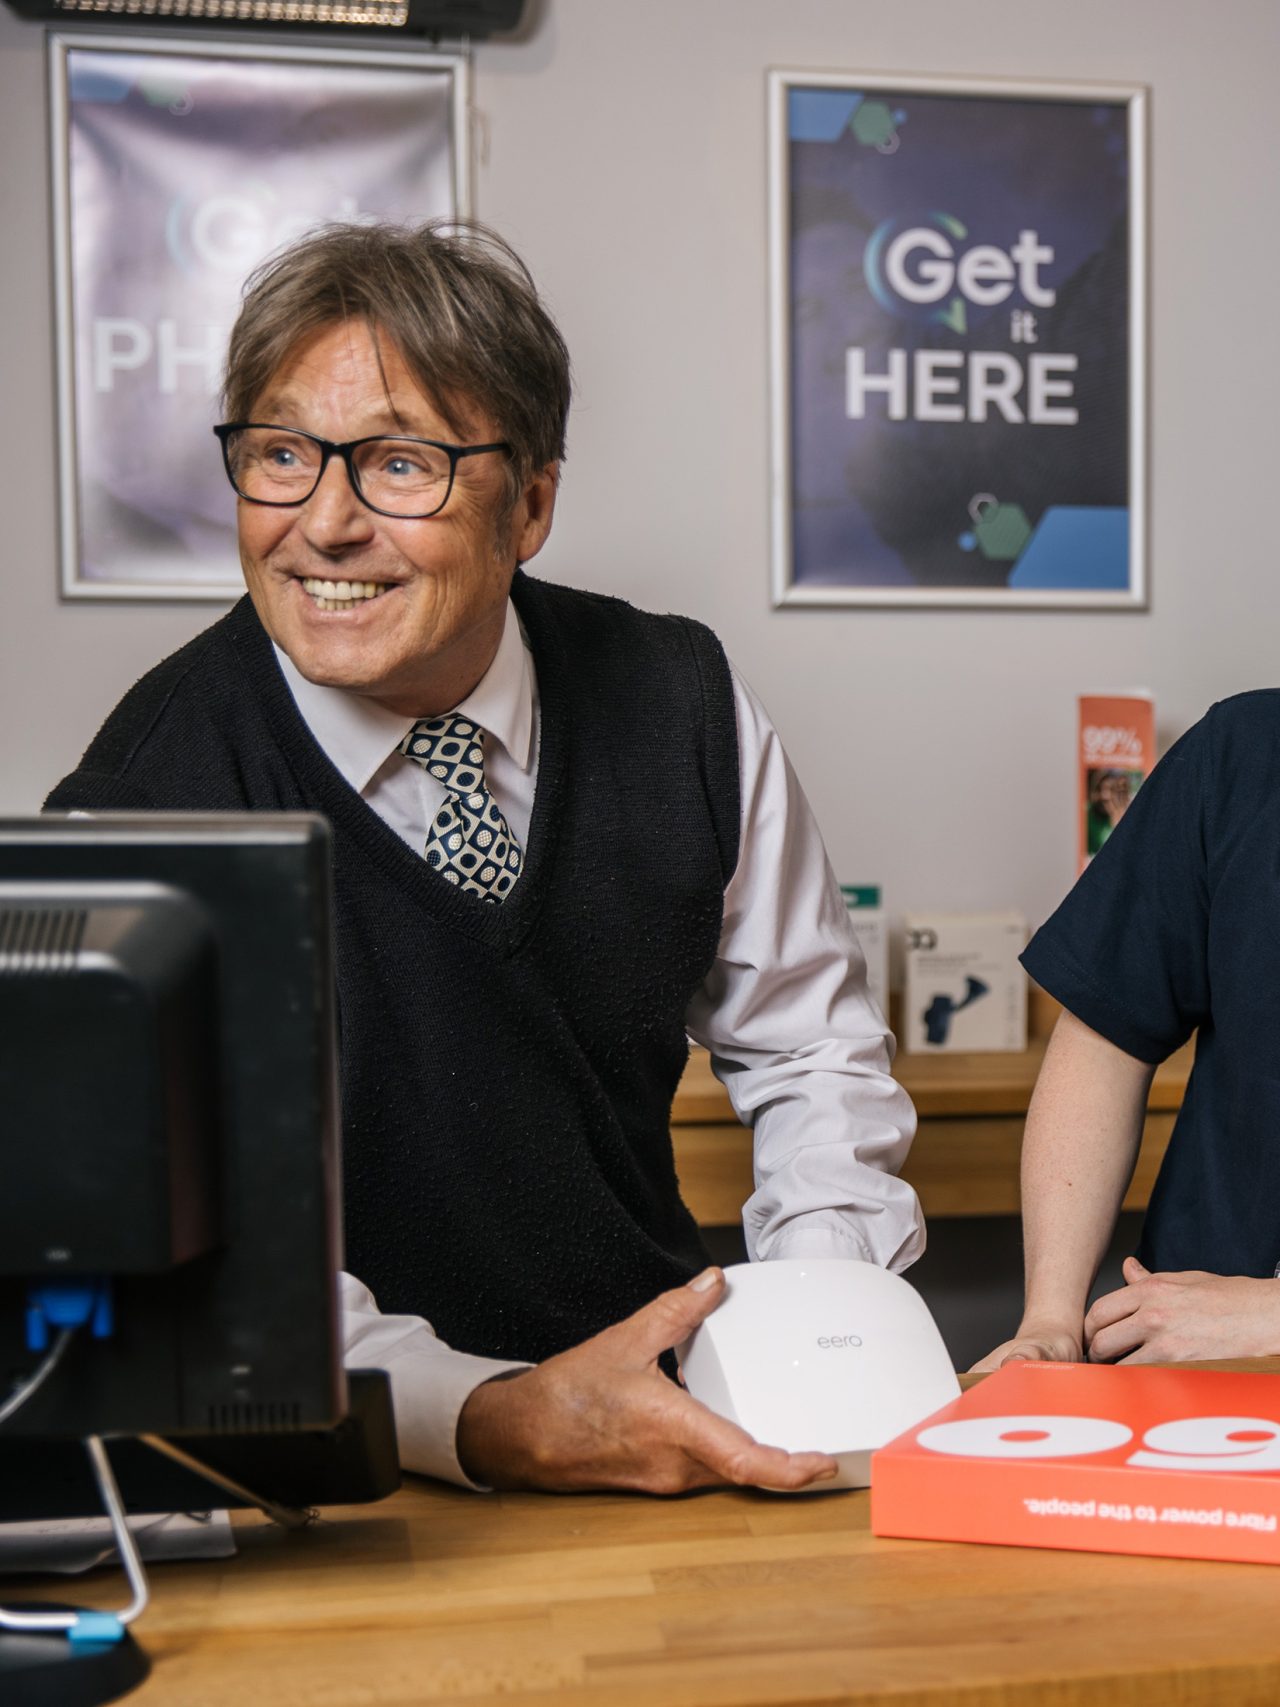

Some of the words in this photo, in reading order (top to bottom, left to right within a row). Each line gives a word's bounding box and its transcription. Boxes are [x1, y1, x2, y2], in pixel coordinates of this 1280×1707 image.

[885, 226, 1056, 308] Get
[1011, 310, 1037, 343] it
[845, 346, 1078, 425] HERE
[816, 1335, 863, 1349] eero
[1098, 1502, 1132, 1521] the
[1134, 1505, 1157, 1523] to
[1159, 1507, 1223, 1526] power
[1224, 1510, 1278, 1532] Fibre
